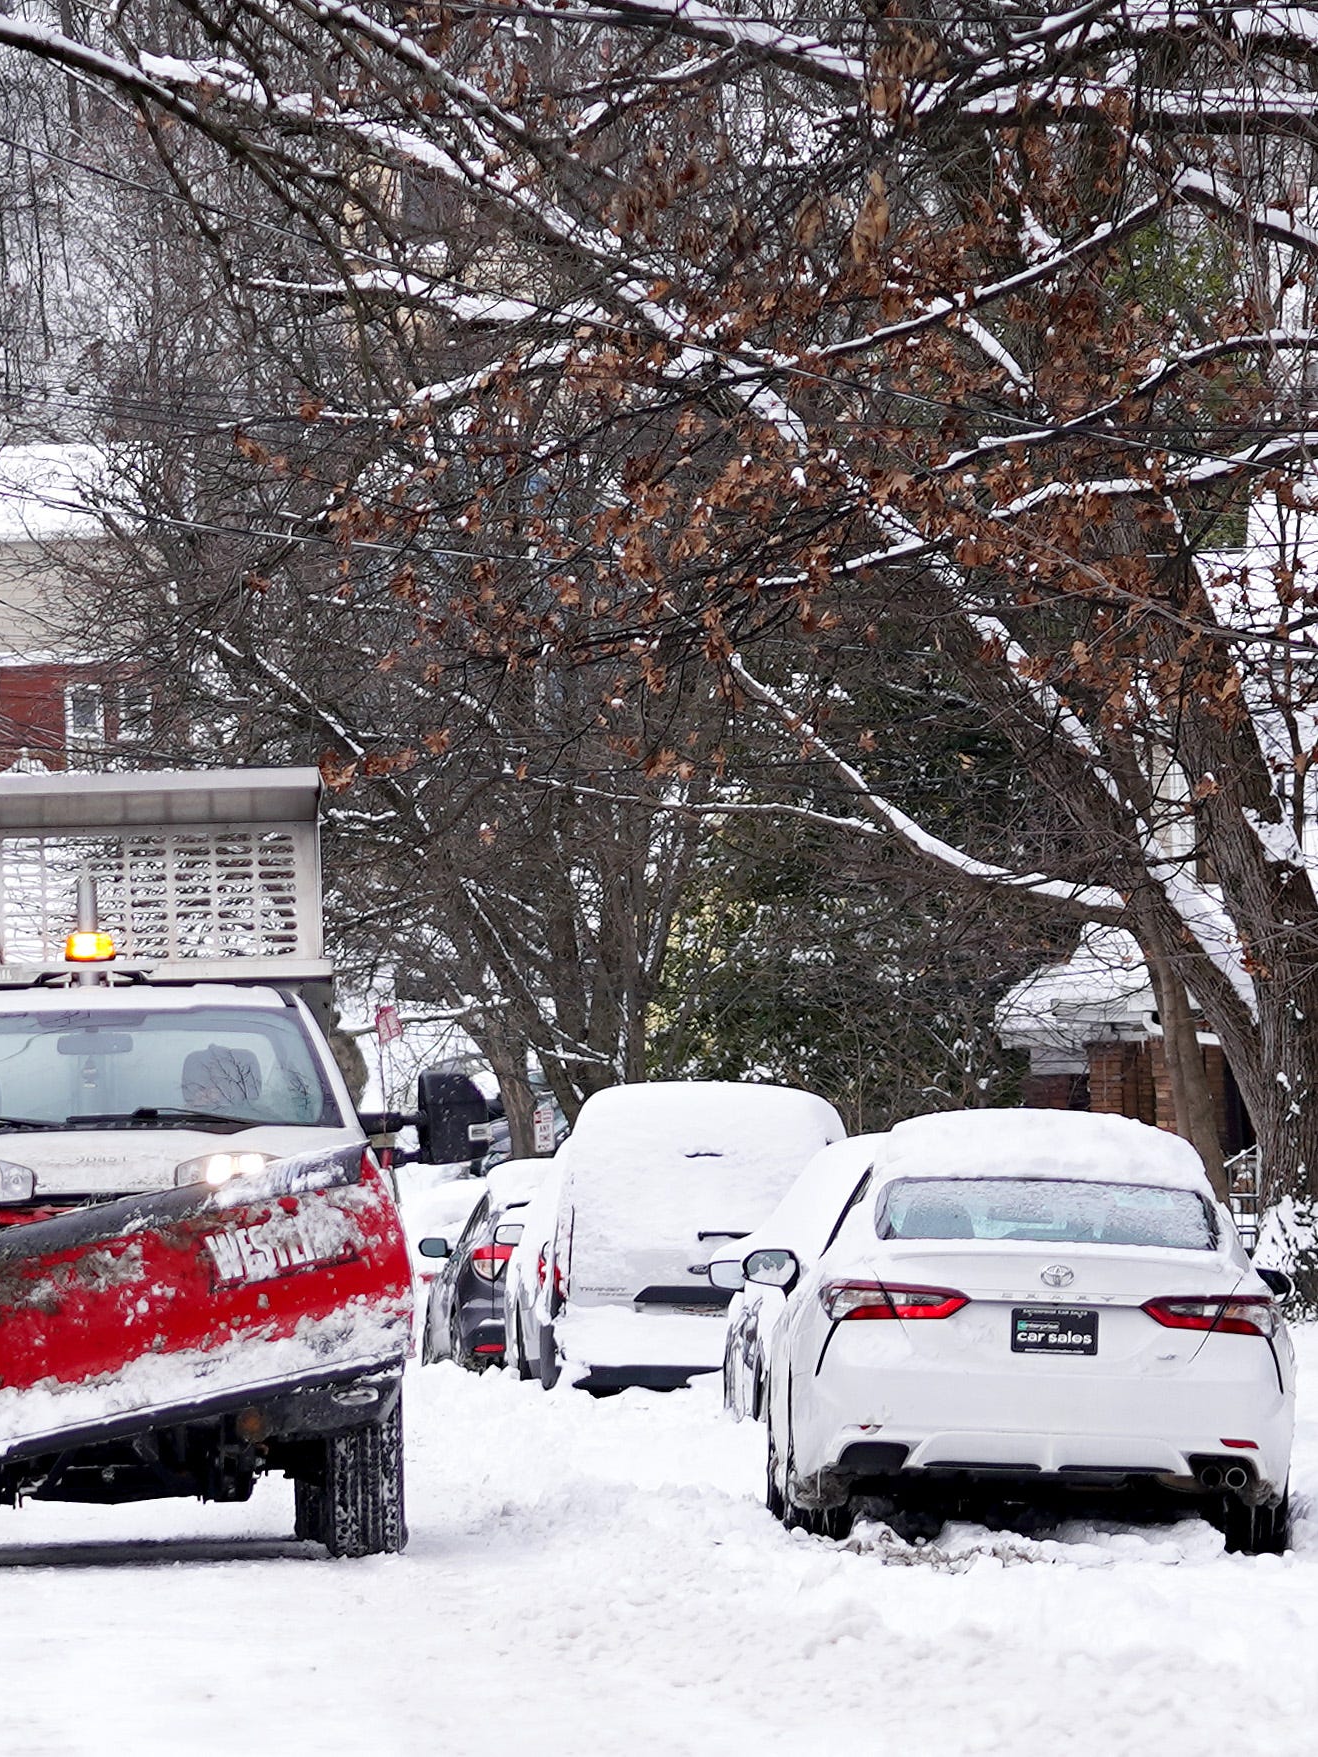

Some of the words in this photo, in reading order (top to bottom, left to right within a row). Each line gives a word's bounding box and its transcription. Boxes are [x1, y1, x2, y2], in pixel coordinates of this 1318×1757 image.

[204, 1208, 347, 1281] WESTE
[1017, 1332, 1045, 1342] car
[1048, 1330, 1093, 1344] sales
